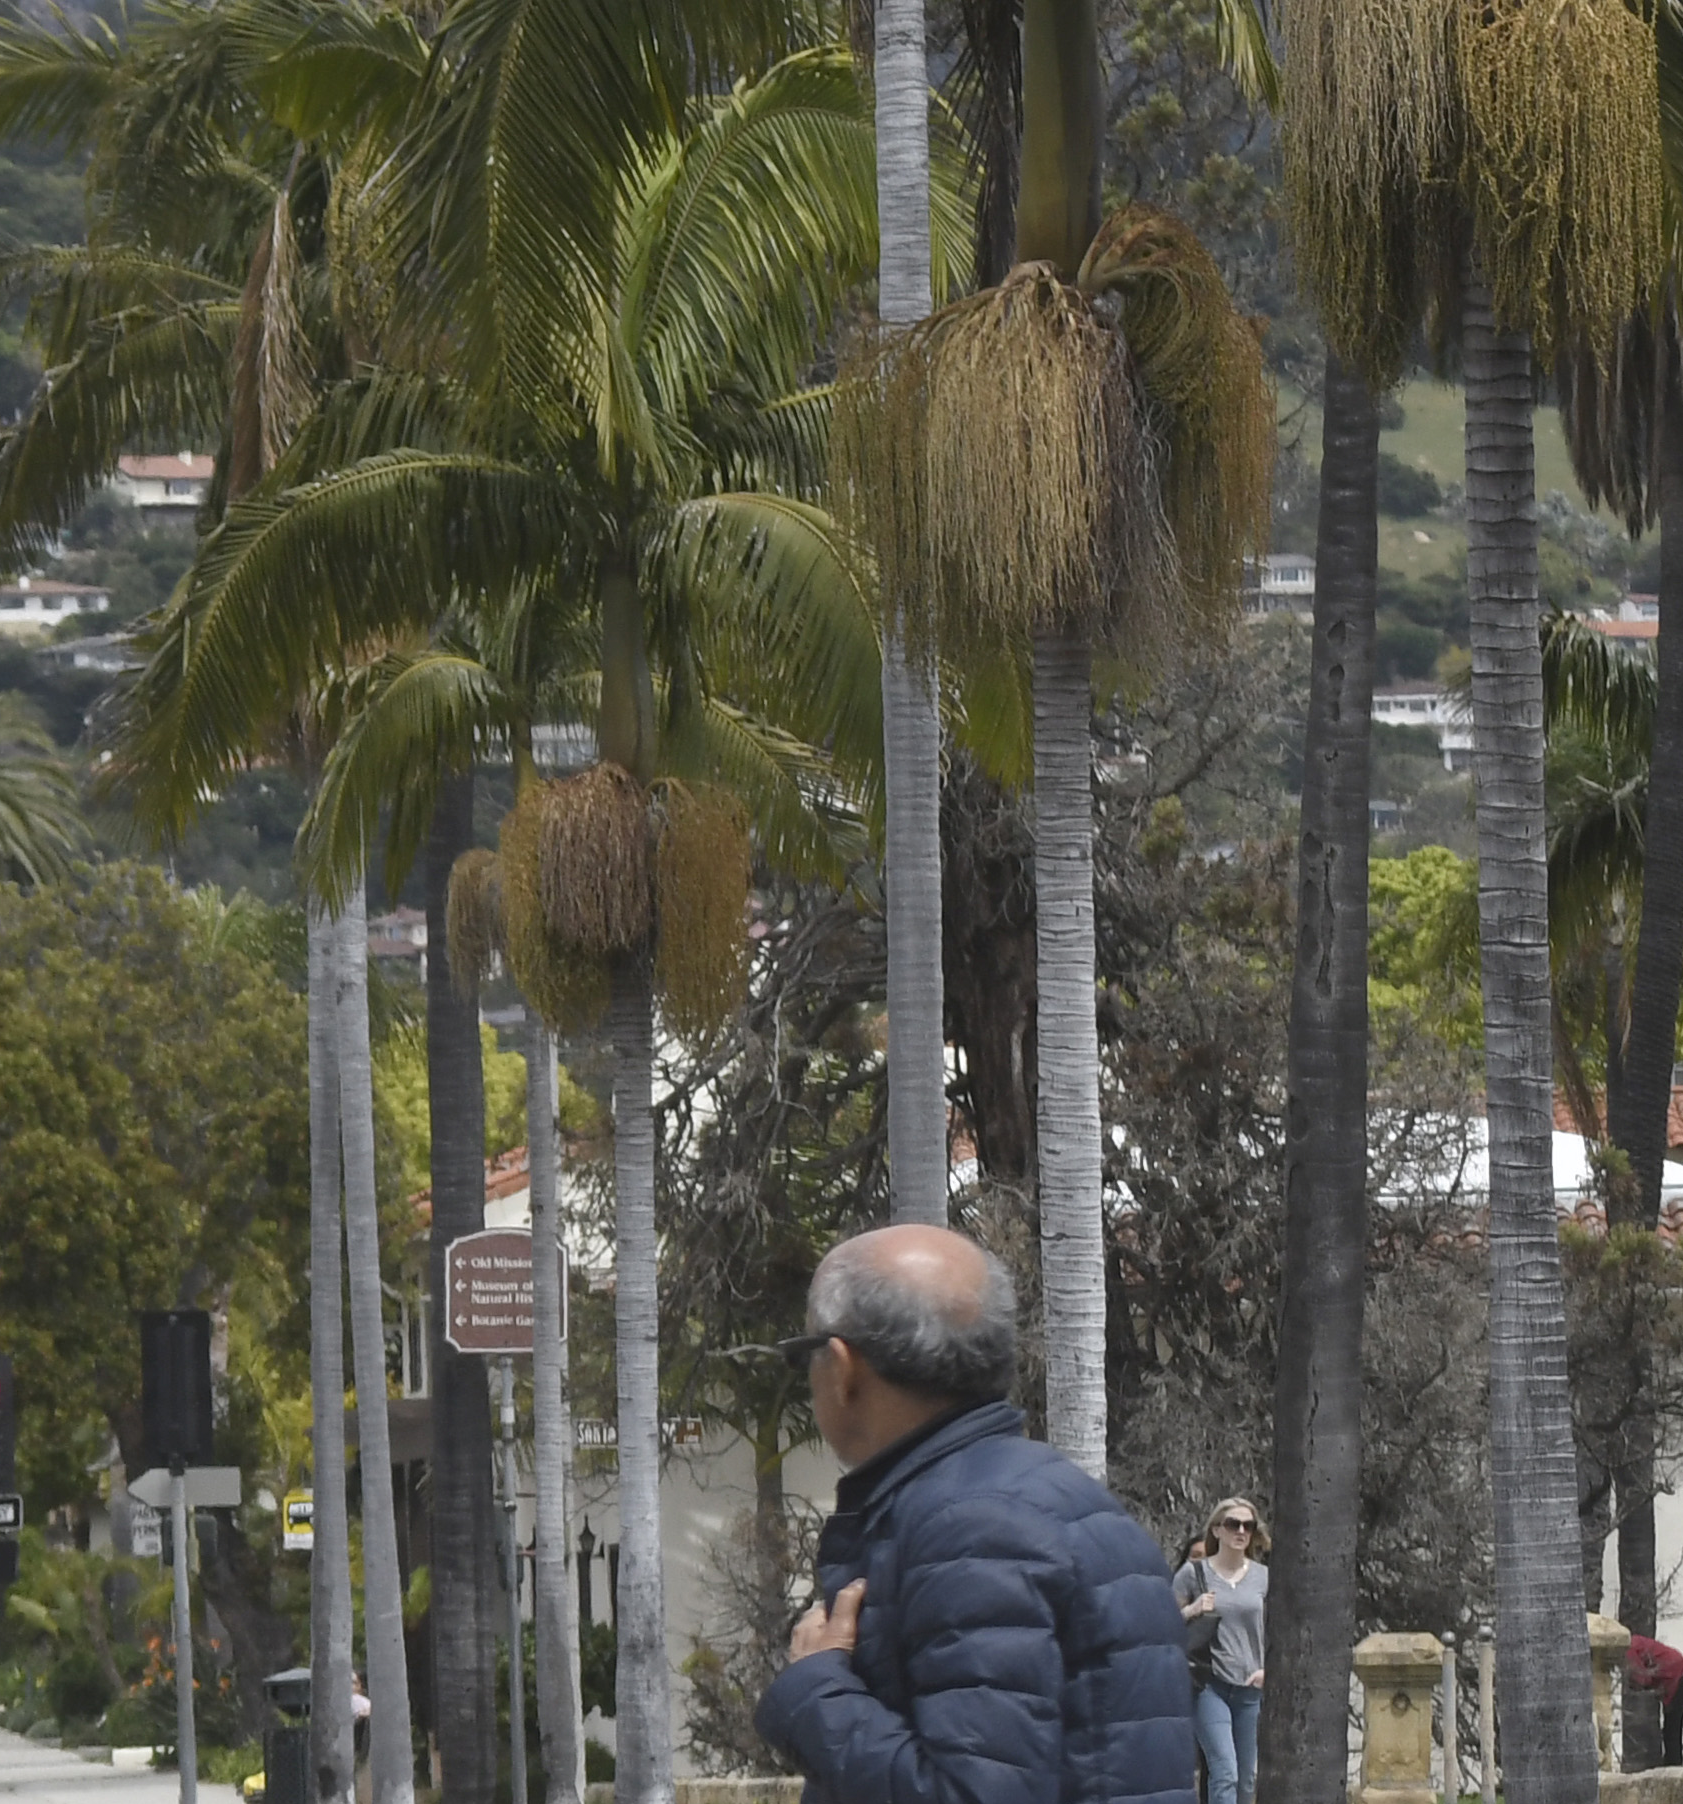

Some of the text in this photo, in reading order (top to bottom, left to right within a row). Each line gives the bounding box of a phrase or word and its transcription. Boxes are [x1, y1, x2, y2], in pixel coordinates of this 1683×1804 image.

[471, 1256, 491, 1269] Old
[472, 1280, 518, 1291] Museum
[471, 1293, 512, 1304] Natural
[472, 1315, 513, 1326] Botanic
